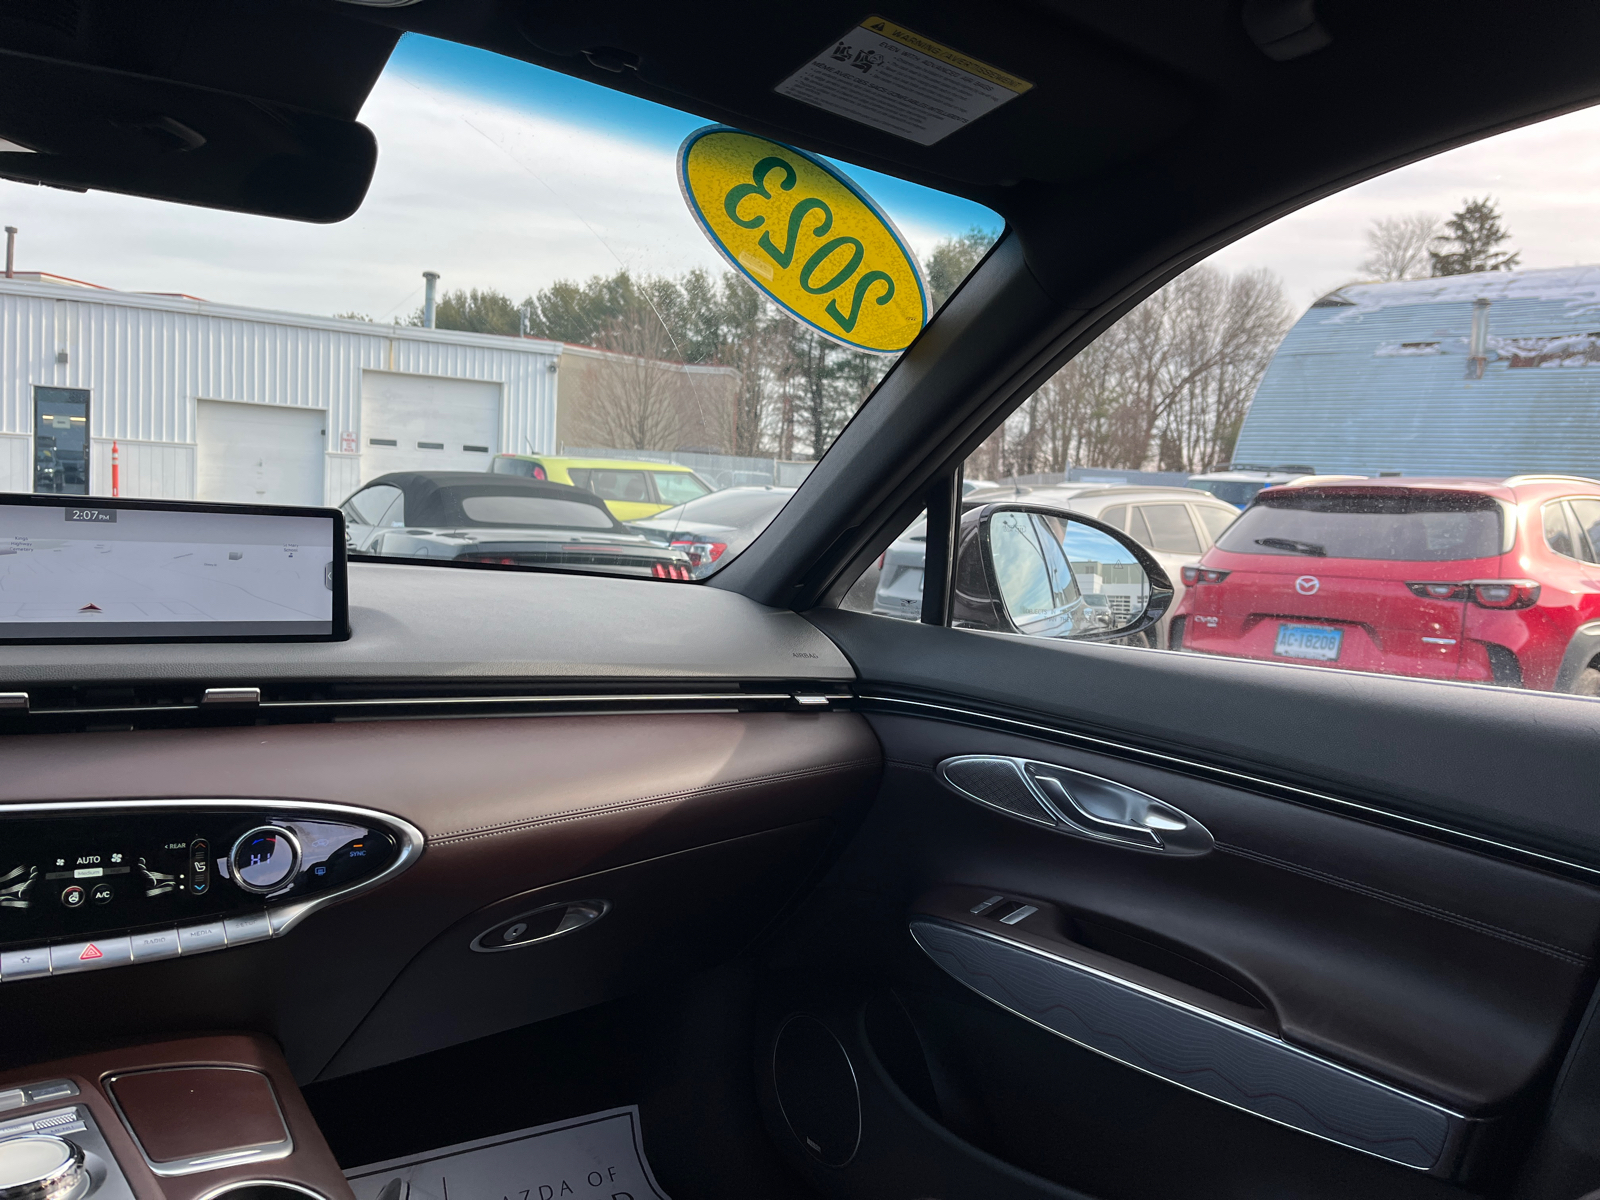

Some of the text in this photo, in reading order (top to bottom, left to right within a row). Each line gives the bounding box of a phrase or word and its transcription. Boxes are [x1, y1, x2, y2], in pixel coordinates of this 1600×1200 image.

[892, 29, 941, 54] WARNING
[879, 41, 900, 53] EVEN
[901, 50, 921, 61] WITH
[921, 60, 961, 77] ADVANCED
[812, 61, 836, 72] MÊME
[833, 70, 855, 79] AVEC
[867, 83, 888, 93] SACS
[73, 510, 98, 520] 2:07
[170, 842, 186, 850] REAR
[350, 850, 366, 858] SYNC
[76, 856, 100, 864] AUTO
[250, 853, 270, 866] HI
[236, 920, 258, 928] SETUP
[190, 929, 212, 937] MEDIA
[144, 937, 166, 945] RADIO
[587, 1166, 617, 1187] OF
